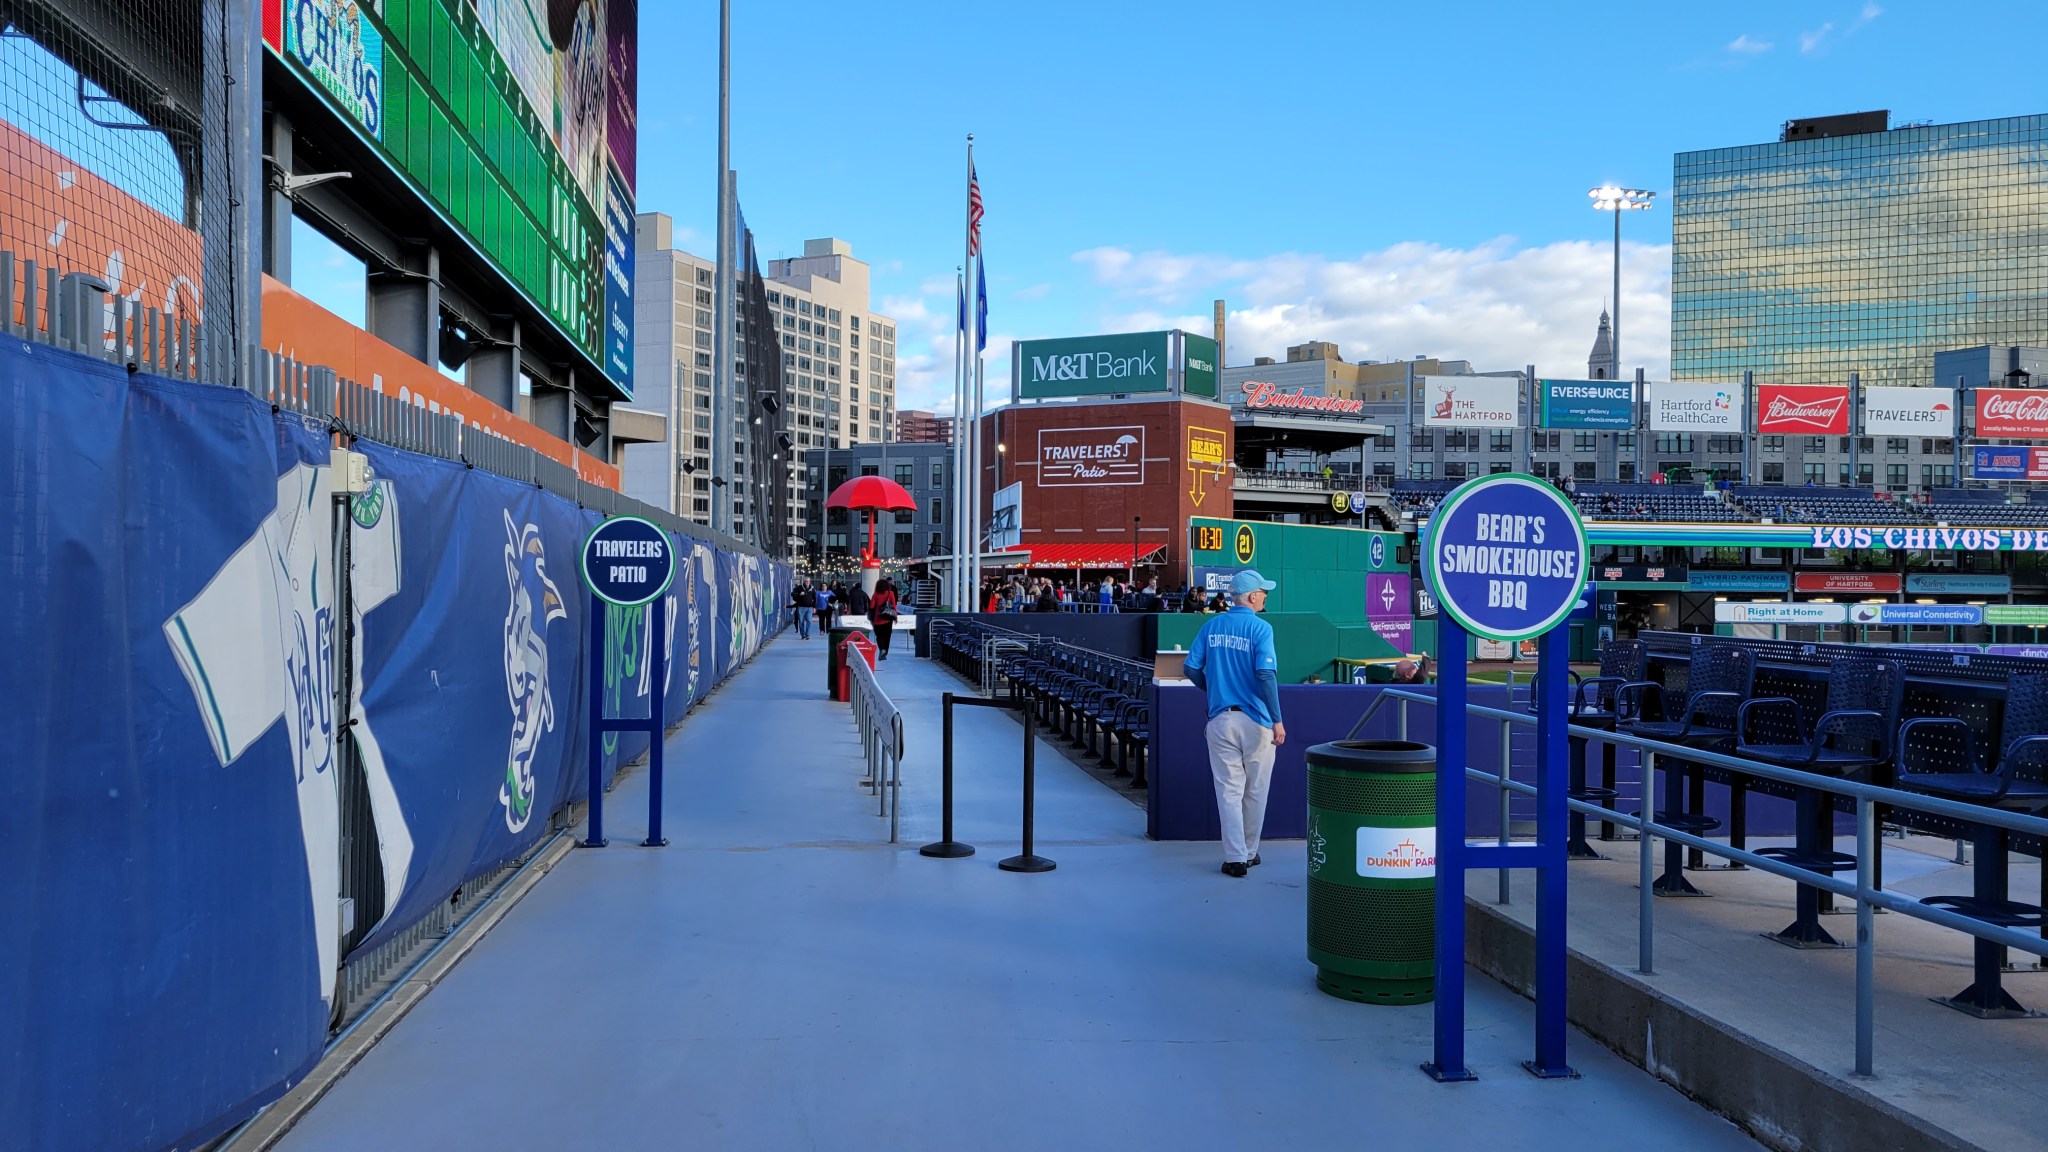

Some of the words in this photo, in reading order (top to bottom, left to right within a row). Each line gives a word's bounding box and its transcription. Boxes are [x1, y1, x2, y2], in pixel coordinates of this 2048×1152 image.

[458, 0, 463, 25] 4
[474, 22, 480, 50] 5
[490, 50, 496, 75] 6
[504, 71, 510, 95] 7
[517, 92, 523, 117] 8
[530, 112, 535, 134] 9
[540, 127, 546, 154] 10
[553, 185, 559, 239] 0
[563, 199, 568, 252] 0
[572, 212, 577, 262] 0
[581, 269, 586, 302] S
[553, 258, 558, 312] 0
[562, 270, 568, 322] 0
[571, 281, 577, 331] 0
[580, 311, 586, 344] O
[1031, 353, 1094, 382] M&T
[1096, 349, 1157, 378] Bank
[1201, 358, 1214, 373] Bank
[1242, 381, 1363, 413] Budweiser
[1551, 386, 1630, 400] EVERSOURCE
[1455, 400, 1475, 409] THE
[1660, 399, 1712, 411] Hartford
[1768, 401, 1837, 418] Budweiser
[1455, 412, 1513, 421] HARTFORD
[1660, 412, 1728, 424] HealthCare
[1867, 409, 1936, 422] TRAVELERS
[1043, 444, 1121, 459] TRAVELERS
[1191, 439, 1222, 457] BEAR'S
[1992, 455, 2021, 467] AWS
[1073, 464, 1109, 478] Patio
[1476, 513, 1546, 544] BEAR'S
[1200, 527, 1222, 550] 0:30
[1239, 534, 1250, 554] 21
[1812, 527, 1873, 549] LOS
[1884, 527, 2001, 550] CHIVOS
[594, 540, 662, 558] TRAVELERS
[1372, 543, 1382, 560] 42
[1442, 544, 1576, 579] SMOKEHOUSE
[609, 566, 647, 583] PATIO
[1920, 577, 1946, 590] Starling
[1487, 579, 1528, 611] BBQ
[1747, 607, 1777, 617] Right
[1780, 608, 1791, 616] at
[1793, 608, 1824, 616] Home
[1882, 609, 1921, 619] Universal
[1922, 609, 1975, 621] Connectivity
[2020, 648, 2048, 658] xfinity
[1366, 857, 1413, 868] DUNKIN'
[1415, 857, 1436, 867] PAR
